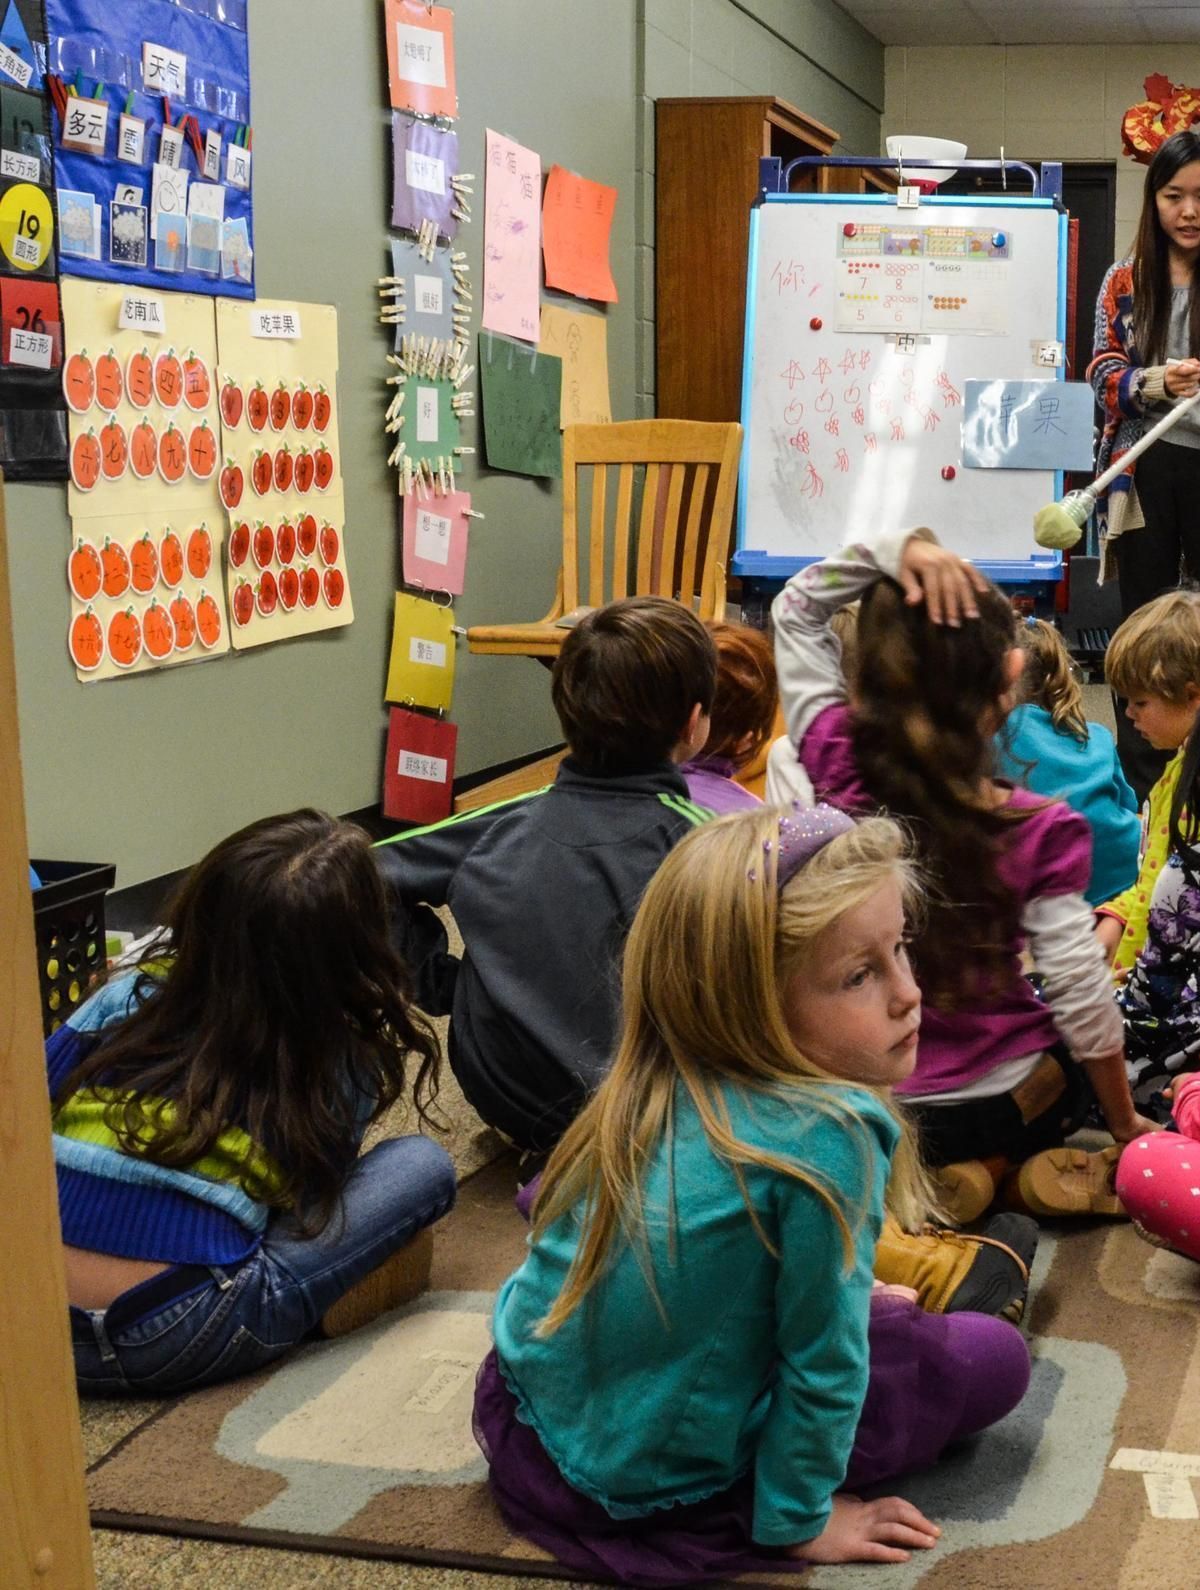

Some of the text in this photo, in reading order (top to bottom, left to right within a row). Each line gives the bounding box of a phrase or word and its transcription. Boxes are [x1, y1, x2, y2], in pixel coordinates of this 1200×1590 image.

[0, 48, 28, 81] 角形
[150, 54, 180, 88] 天气
[68, 109, 102, 141] 多云
[3, 154, 38, 178] 长方形
[233, 156, 247, 182] 风
[18, 209, 41, 240] 19
[15, 239, 38, 262] 圆形
[859, 276, 904, 291] 7 8
[16, 306, 47, 334] 26
[125, 298, 161, 322] 吃南瓜
[856, 308, 904, 323] 5 6
[260, 314, 296, 334] 吃苹果
[14, 333, 49, 354] 正方形
[898, 332, 916, 352] 中
[102, 374, 115, 395] 二
[133, 369, 146, 399] 三
[160, 369, 175, 395] 四
[188, 371, 204, 395] 五
[275, 401, 284, 420] 3
[297, 400, 306, 420] 4
[316, 402, 325, 421] 5
[999, 394, 1068, 435] 苹果
[81, 439, 208, 474] 六 七 八 九 十
[78, 634, 95, 651] 十六
[113, 630, 134, 649] 十七
[148, 625, 167, 642] 十八
[174, 618, 190, 632] 十九
